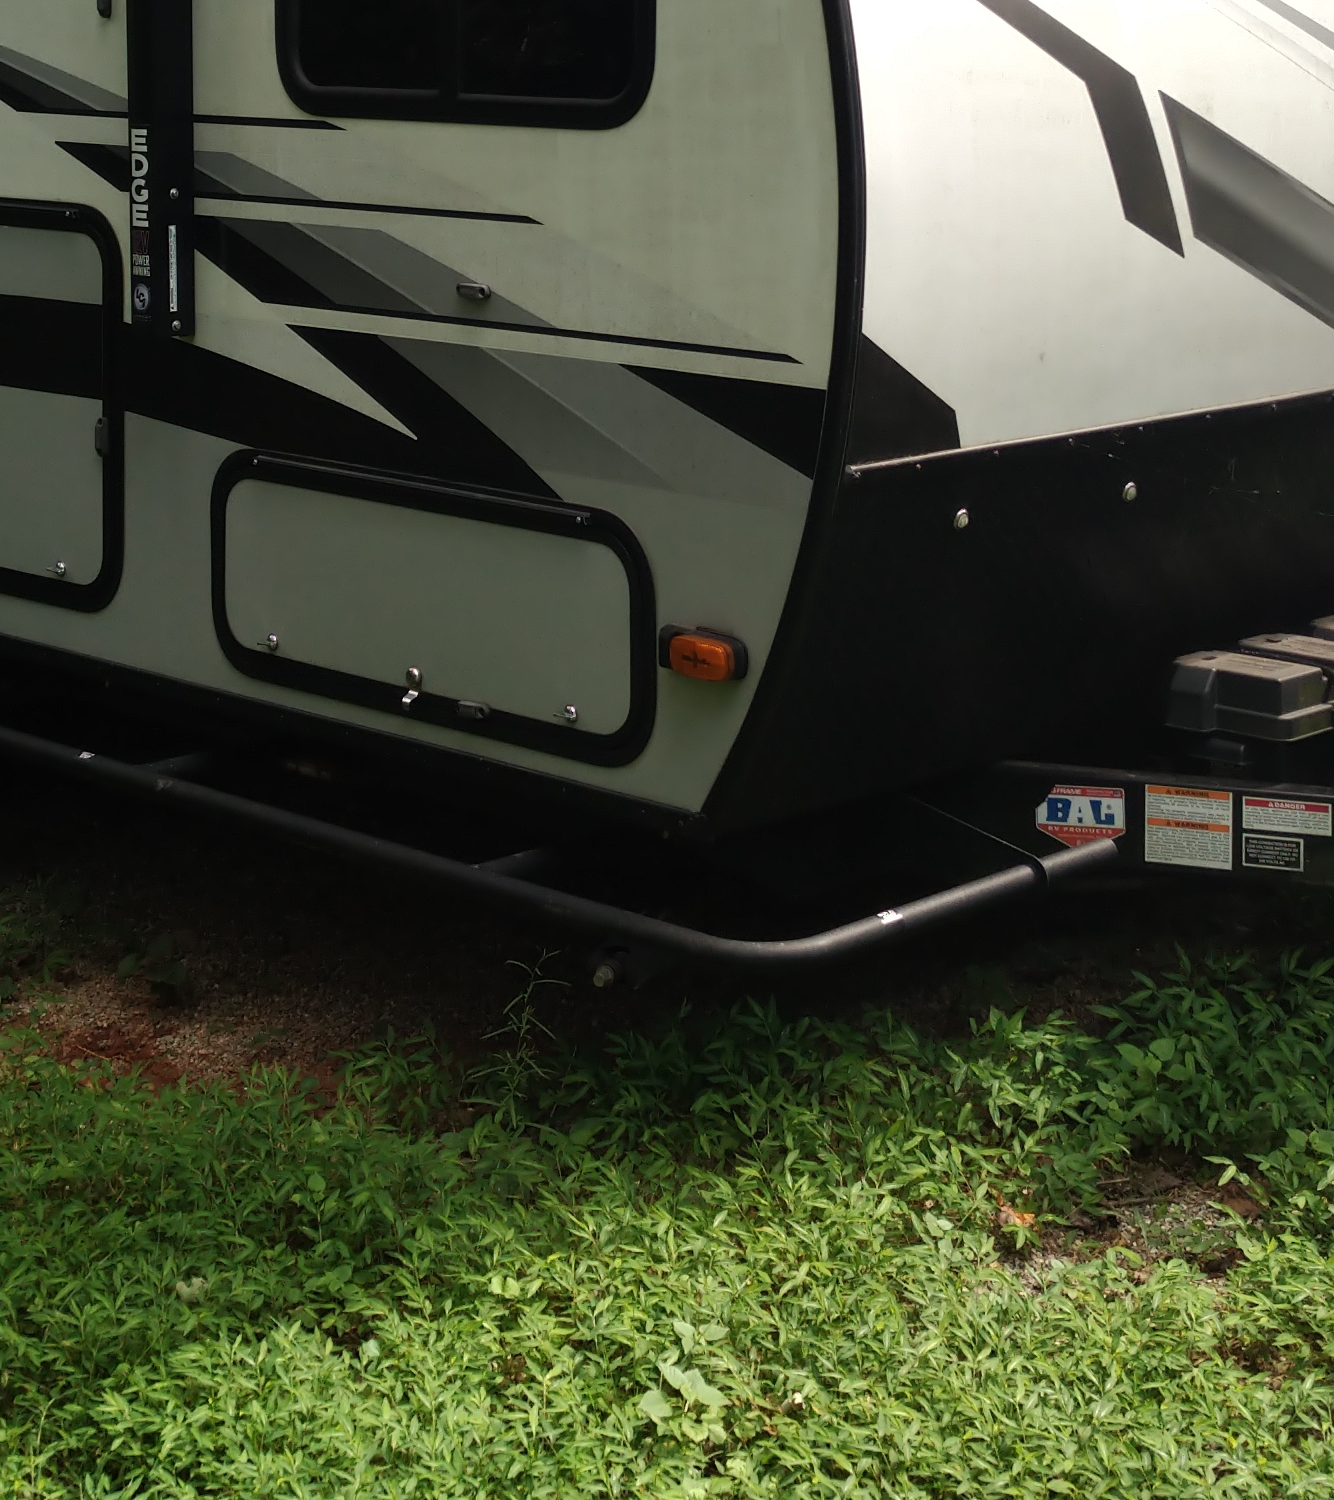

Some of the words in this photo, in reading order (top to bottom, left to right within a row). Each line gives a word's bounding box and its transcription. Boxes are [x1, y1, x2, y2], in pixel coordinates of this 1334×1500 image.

[131, 128, 149, 227] EDGE
[133, 253, 150, 266] POWER
[1175, 789, 1209, 797] WARNING
[1274, 801, 1306, 810] DANGER
[1046, 797, 1115, 826] BAL
[1175, 821, 1209, 830] WARNING
[1063, 826, 1113, 835] PRODUCTS
